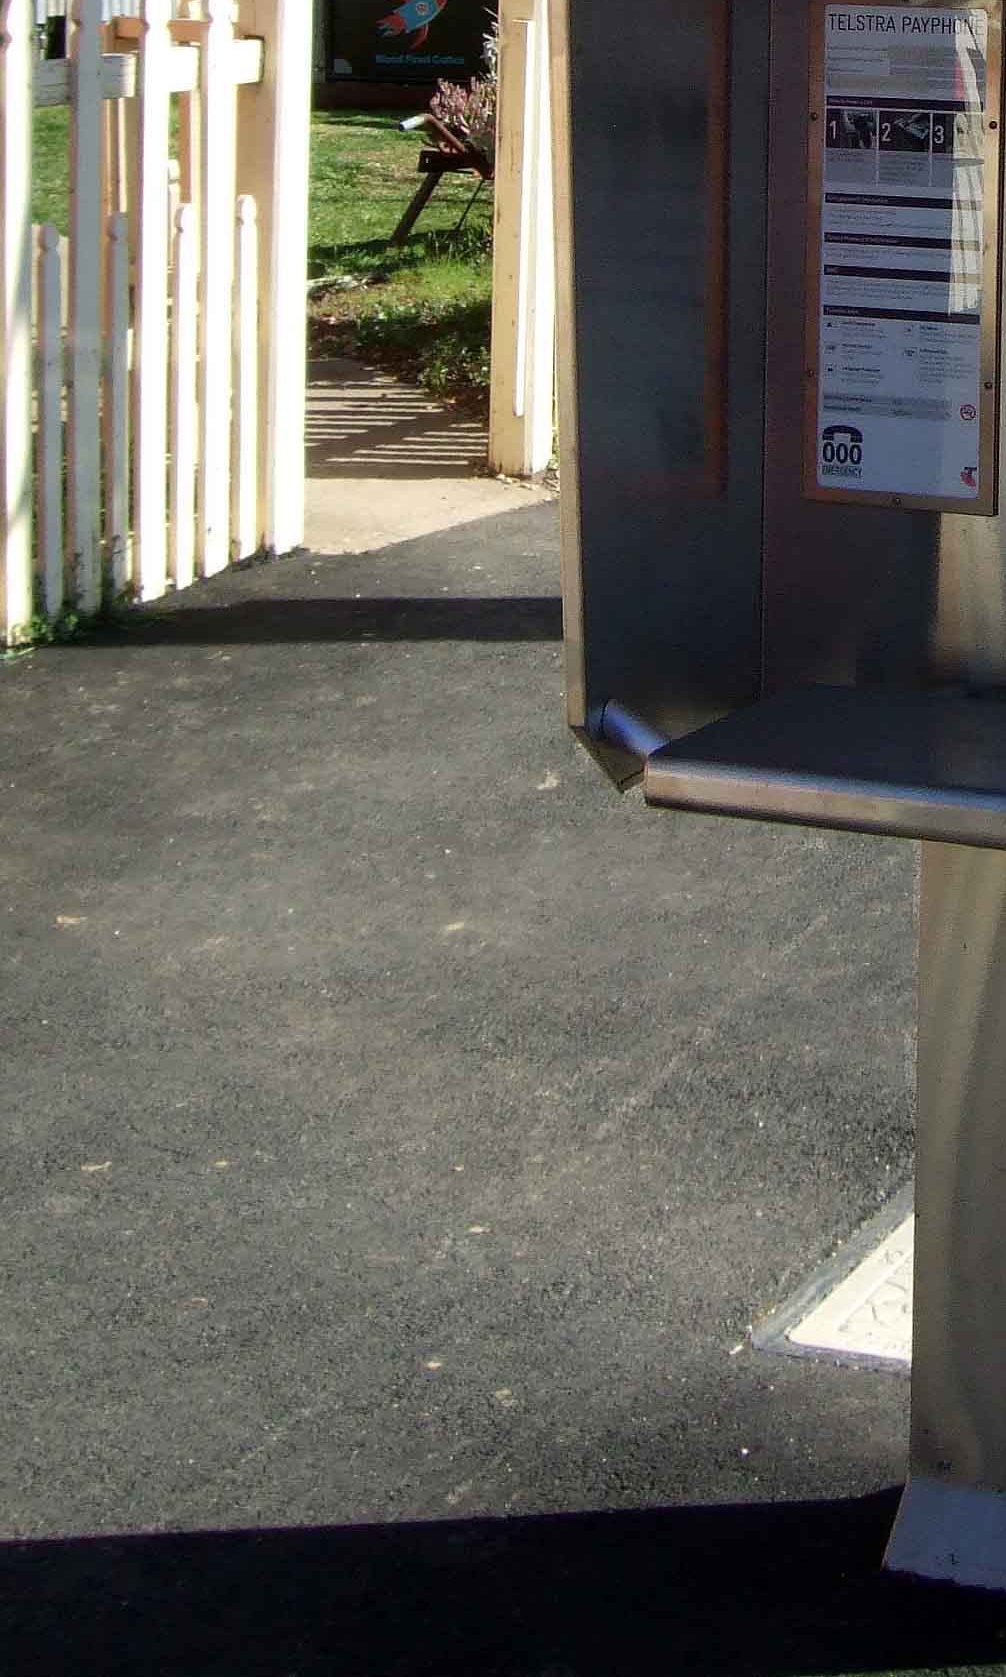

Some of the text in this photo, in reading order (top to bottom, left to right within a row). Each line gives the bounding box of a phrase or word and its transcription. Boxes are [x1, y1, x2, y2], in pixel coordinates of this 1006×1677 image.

[829, 13, 896, 32] TELSTRA
[829, 121, 945, 145] 1 2 3
[822, 441, 863, 465] 000
